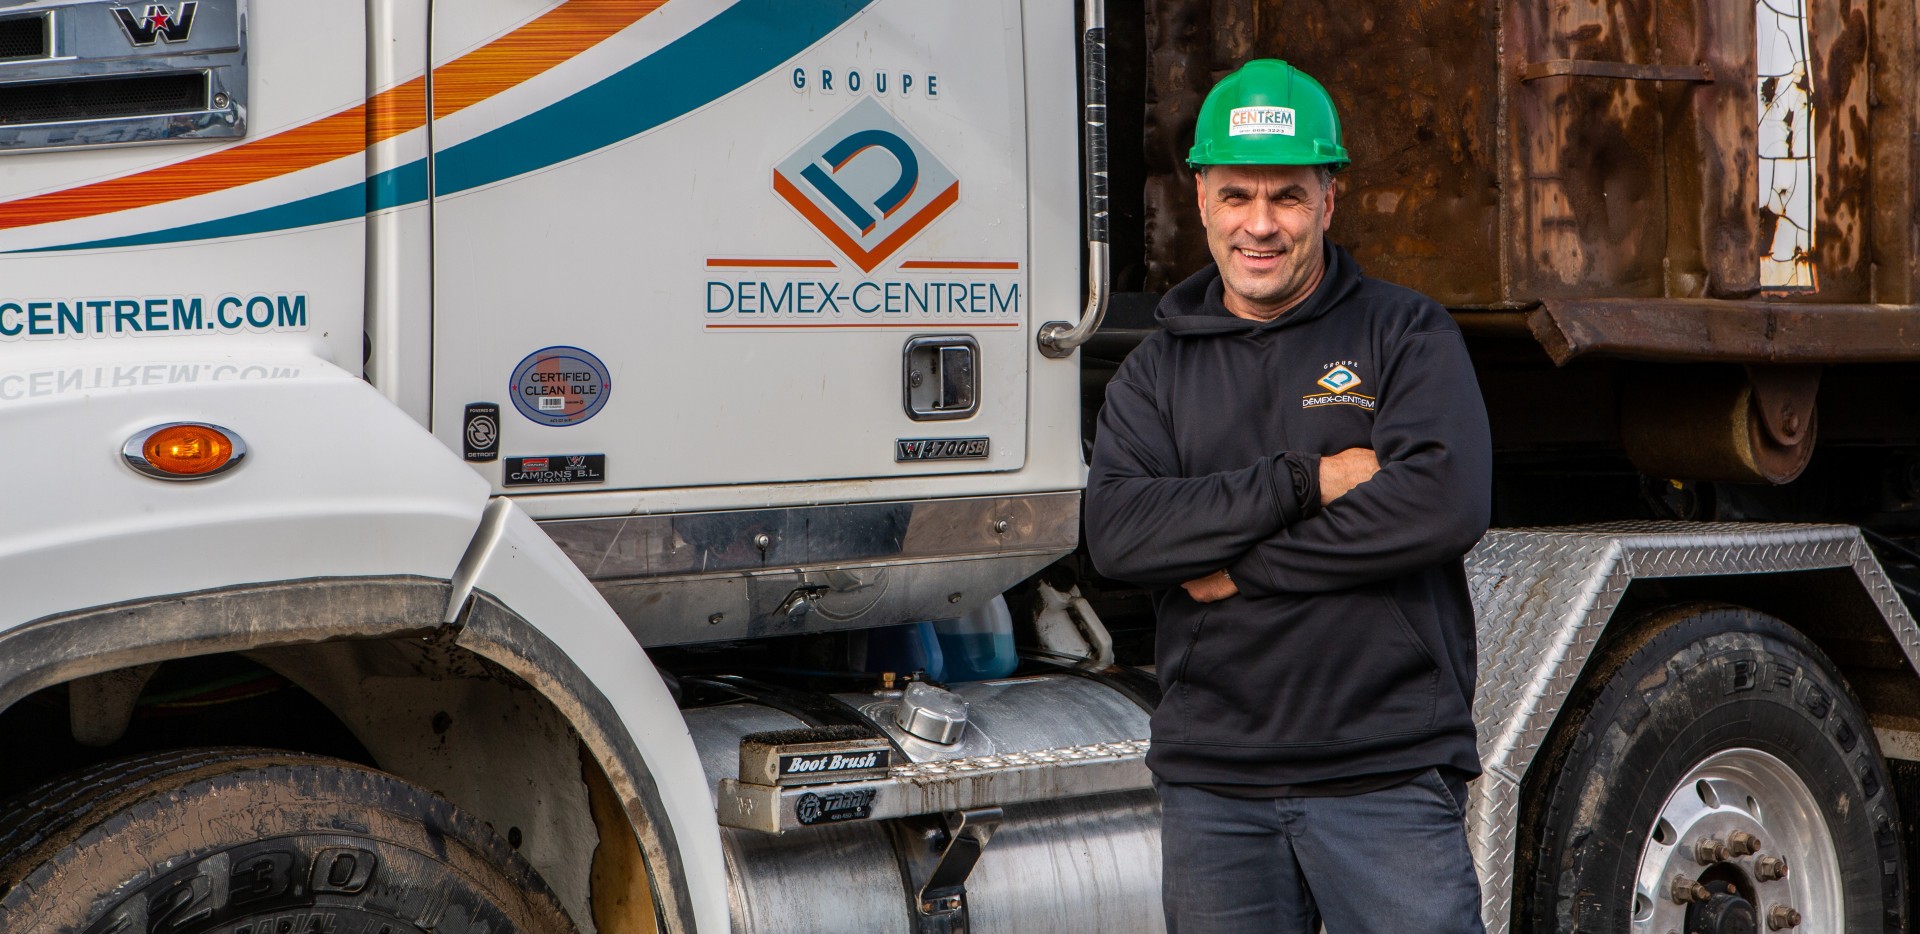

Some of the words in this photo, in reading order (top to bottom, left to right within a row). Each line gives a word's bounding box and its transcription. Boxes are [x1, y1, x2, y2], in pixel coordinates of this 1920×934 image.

[793, 67, 938, 95] GROUPE
[1232, 110, 1293, 125] CENTREM
[707, 281, 1018, 313] DEMEX-CENTREM
[0, 295, 306, 336] CENTREM.COM
[1323, 361, 1358, 369] GROUPE
[531, 372, 591, 382] CERTIFIED
[525, 386, 565, 395] CLEAN
[571, 385, 597, 394] IDLE
[511, 470, 572, 480] CAMIONS
[577, 469, 600, 477] B.L.
[787, 756, 828, 773] Boot
[828, 752, 878, 771] Brush
